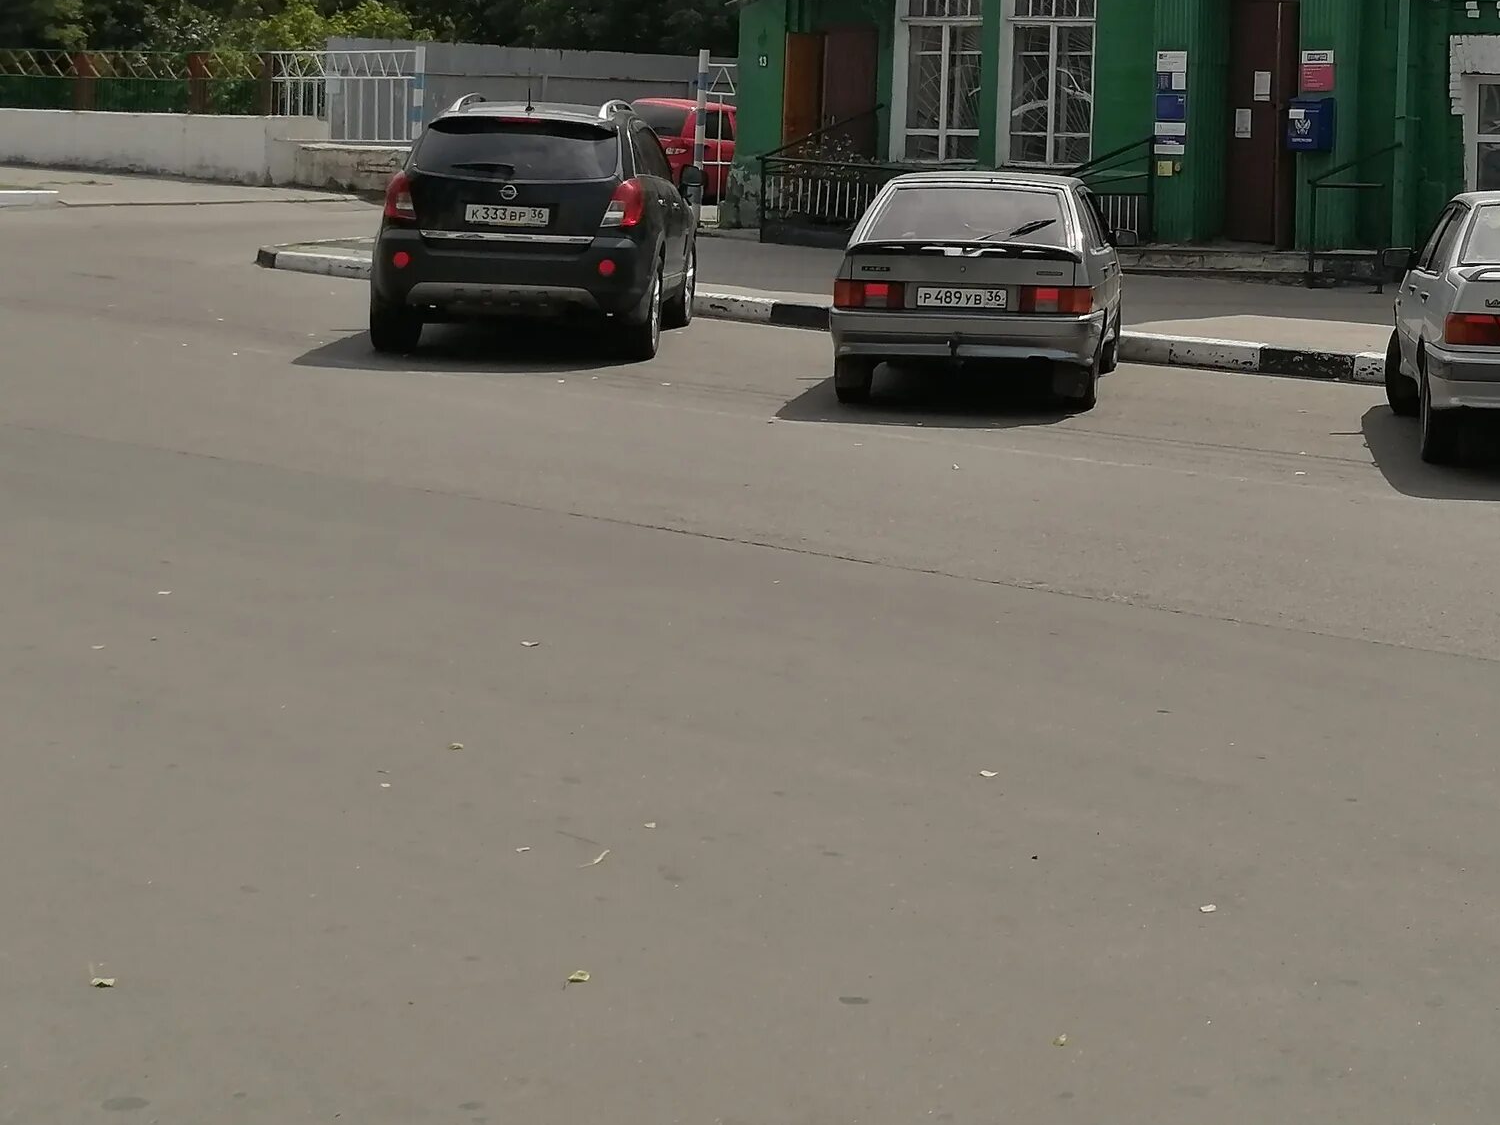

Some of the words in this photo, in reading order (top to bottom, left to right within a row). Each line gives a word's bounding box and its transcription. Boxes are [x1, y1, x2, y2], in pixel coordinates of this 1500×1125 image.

[530, 209, 544, 219] 36
[923, 290, 982, 305] Р489УВ
[986, 291, 1002, 302] 36
